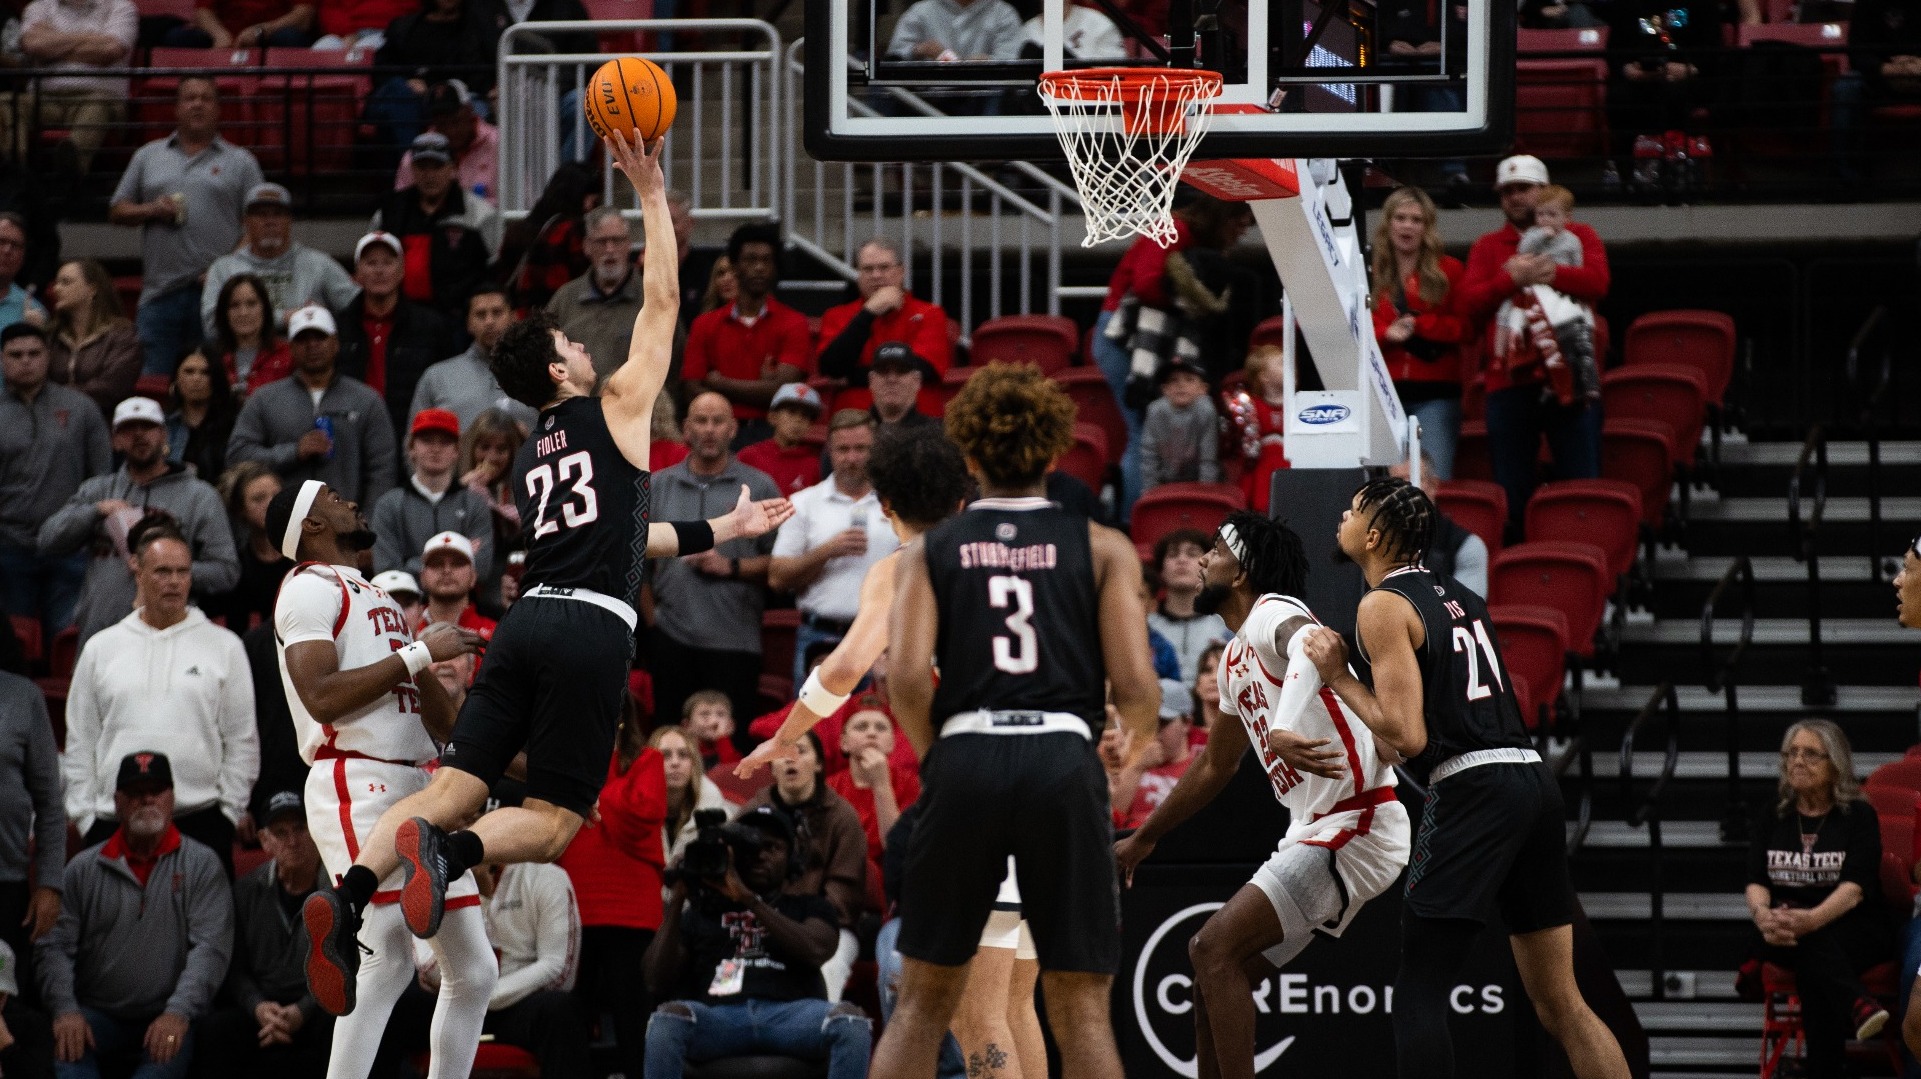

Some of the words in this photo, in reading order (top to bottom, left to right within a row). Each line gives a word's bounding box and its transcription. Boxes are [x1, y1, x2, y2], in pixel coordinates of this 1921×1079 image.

[536, 429, 568, 459] FIDLER
[525, 450, 598, 541] 23
[988, 575, 1038, 674] 3
[1452, 618, 1504, 701] 21
[391, 685, 421, 714] TE
[1767, 849, 1810, 870] TEXAS
[1157, 973, 1504, 1014] CREnocs
